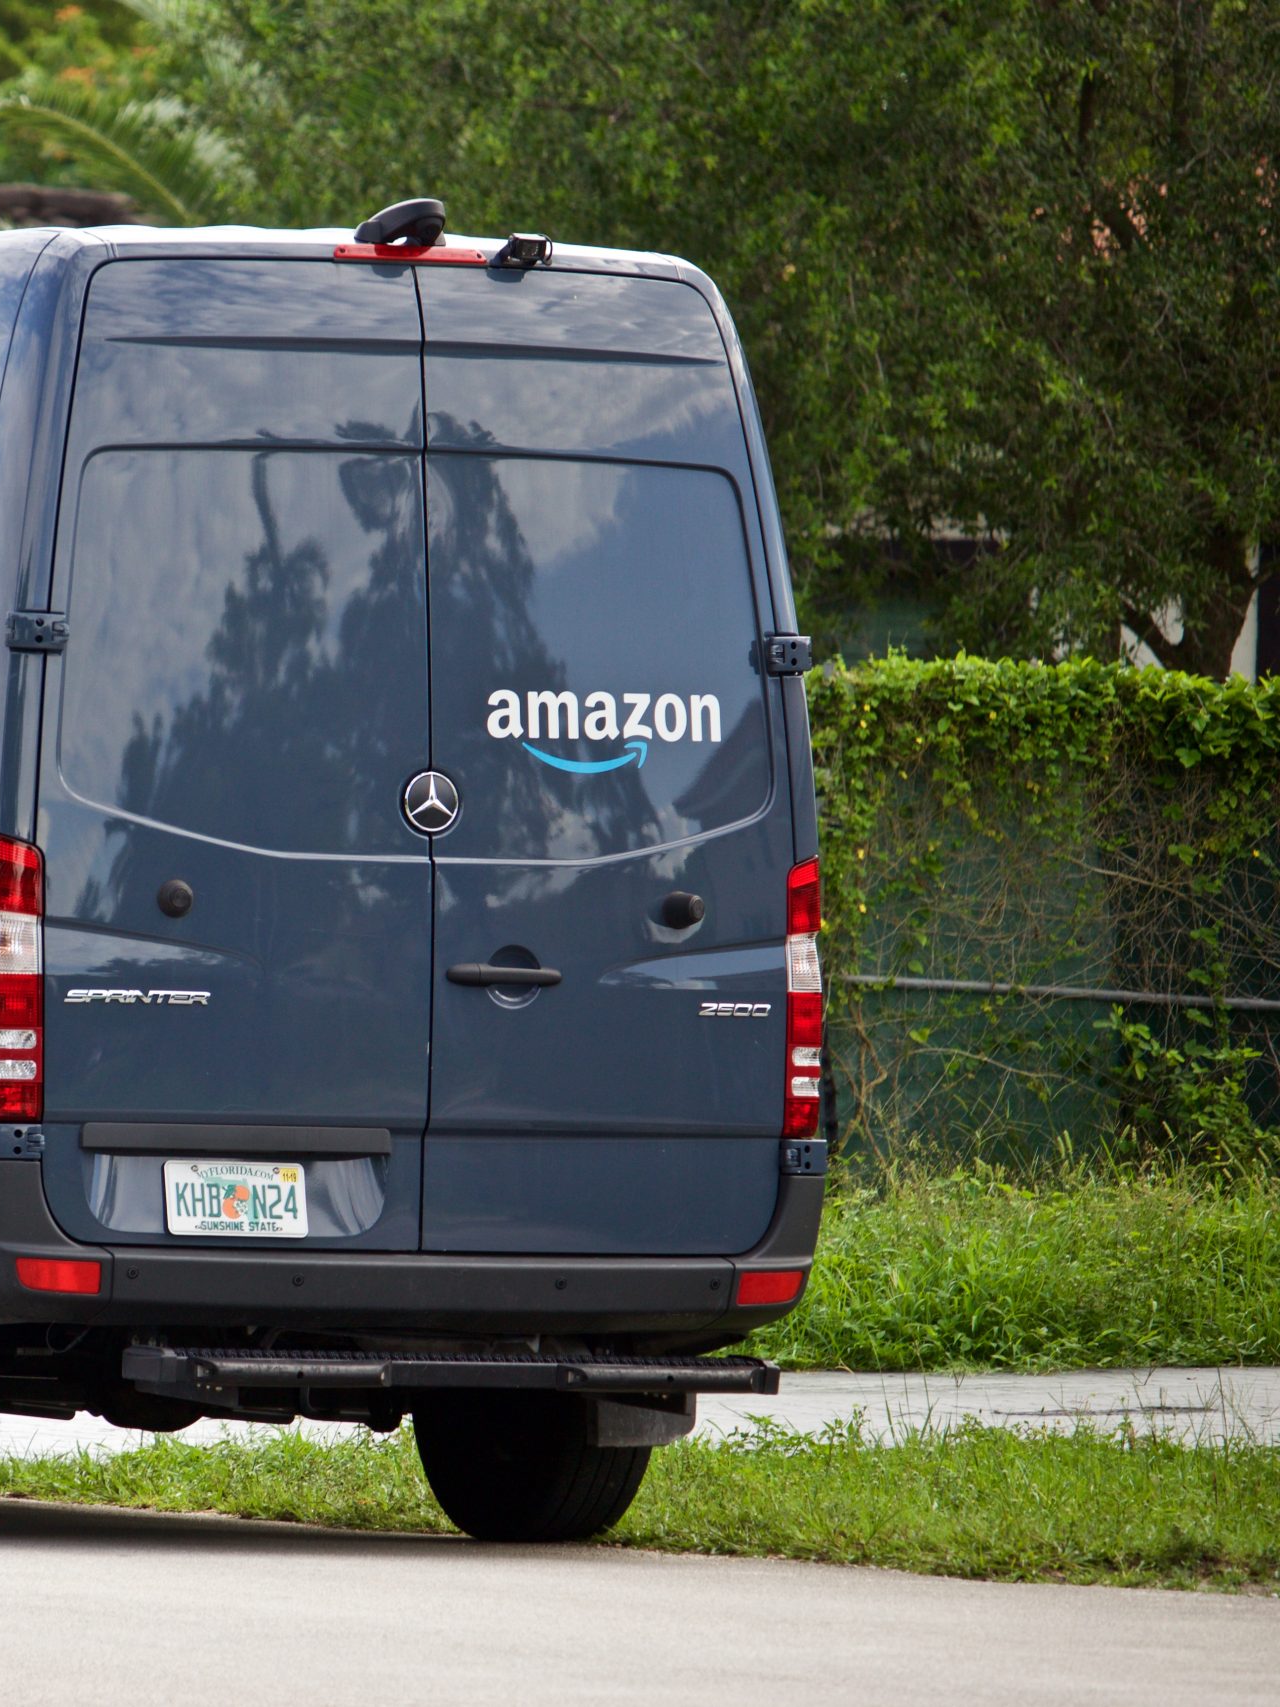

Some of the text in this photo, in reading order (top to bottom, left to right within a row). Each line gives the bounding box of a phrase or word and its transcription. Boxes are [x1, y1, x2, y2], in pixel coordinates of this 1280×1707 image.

[487, 689, 722, 742] amazon
[64, 989, 211, 1005] SPRINTER
[699, 1003, 771, 1016] 2500
[175, 1182, 298, 1219] KHB N24
[201, 1221, 277, 1232] SUNSHINE STATE
